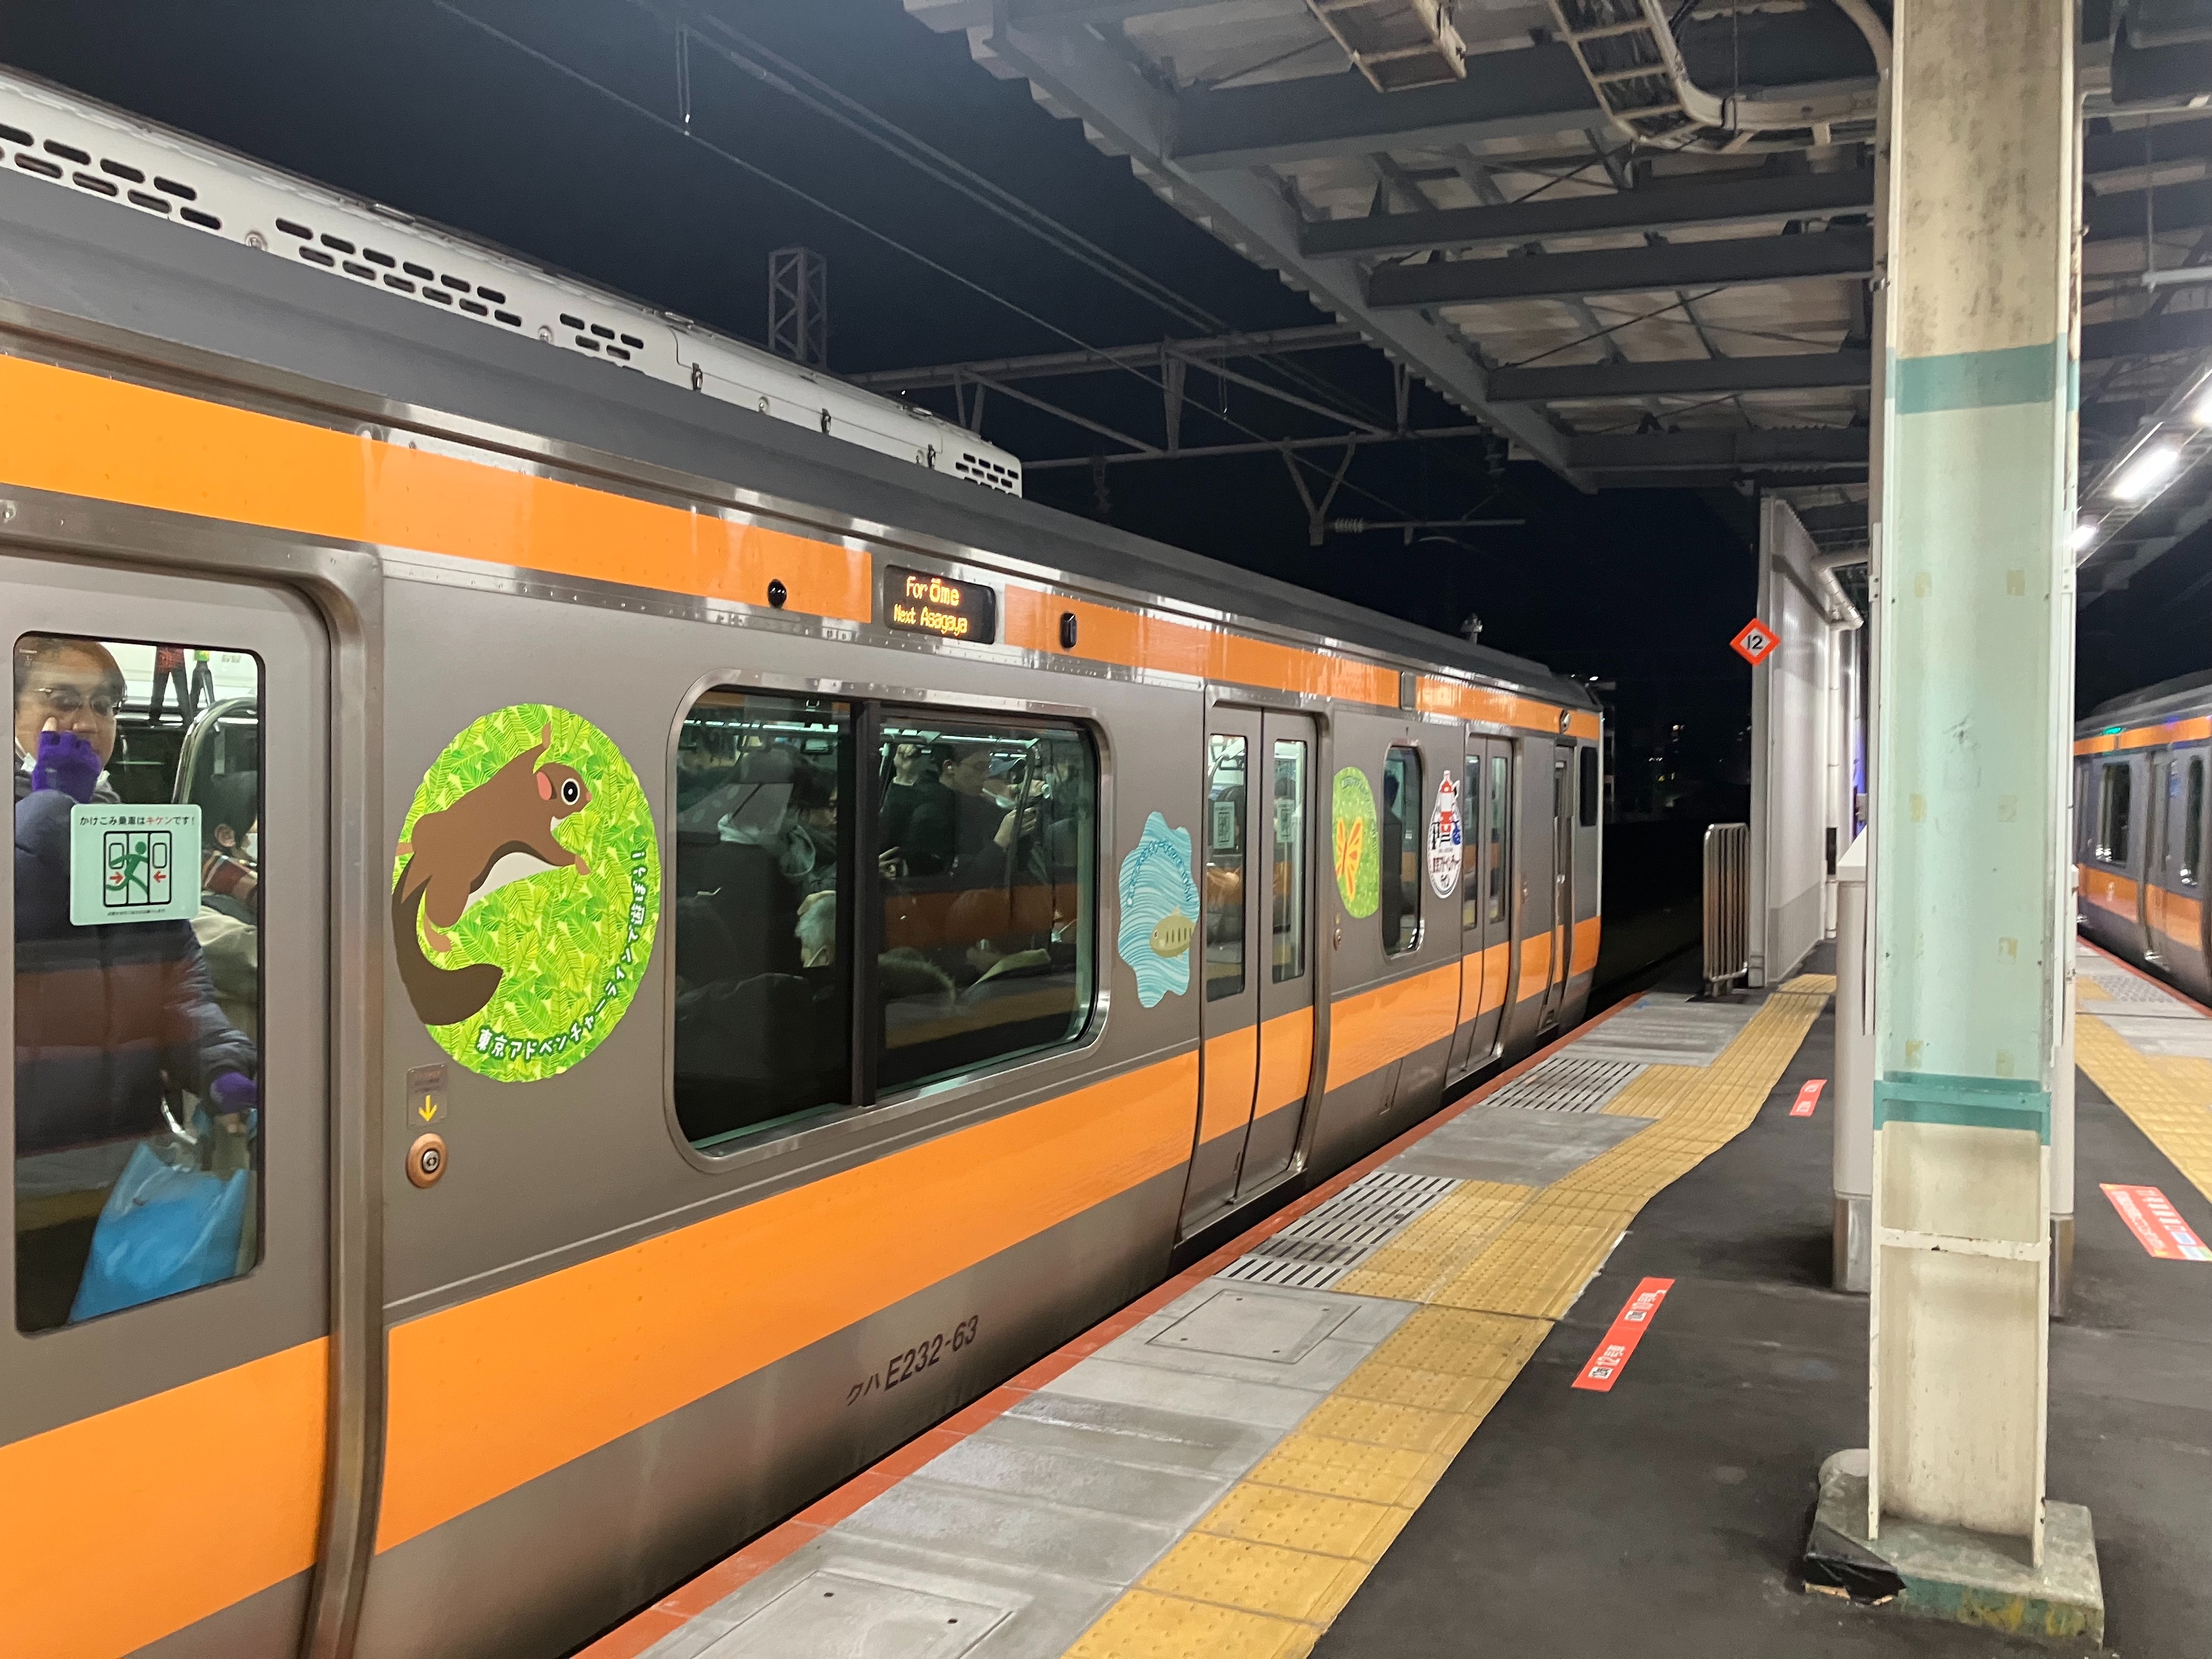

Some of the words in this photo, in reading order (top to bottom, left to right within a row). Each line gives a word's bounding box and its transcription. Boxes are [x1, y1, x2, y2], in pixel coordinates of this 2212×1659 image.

[906, 575, 928, 600] For
[894, 603, 917, 624] Next
[920, 606, 968, 637] Asagaya
[1747, 635, 1764, 651] 12
